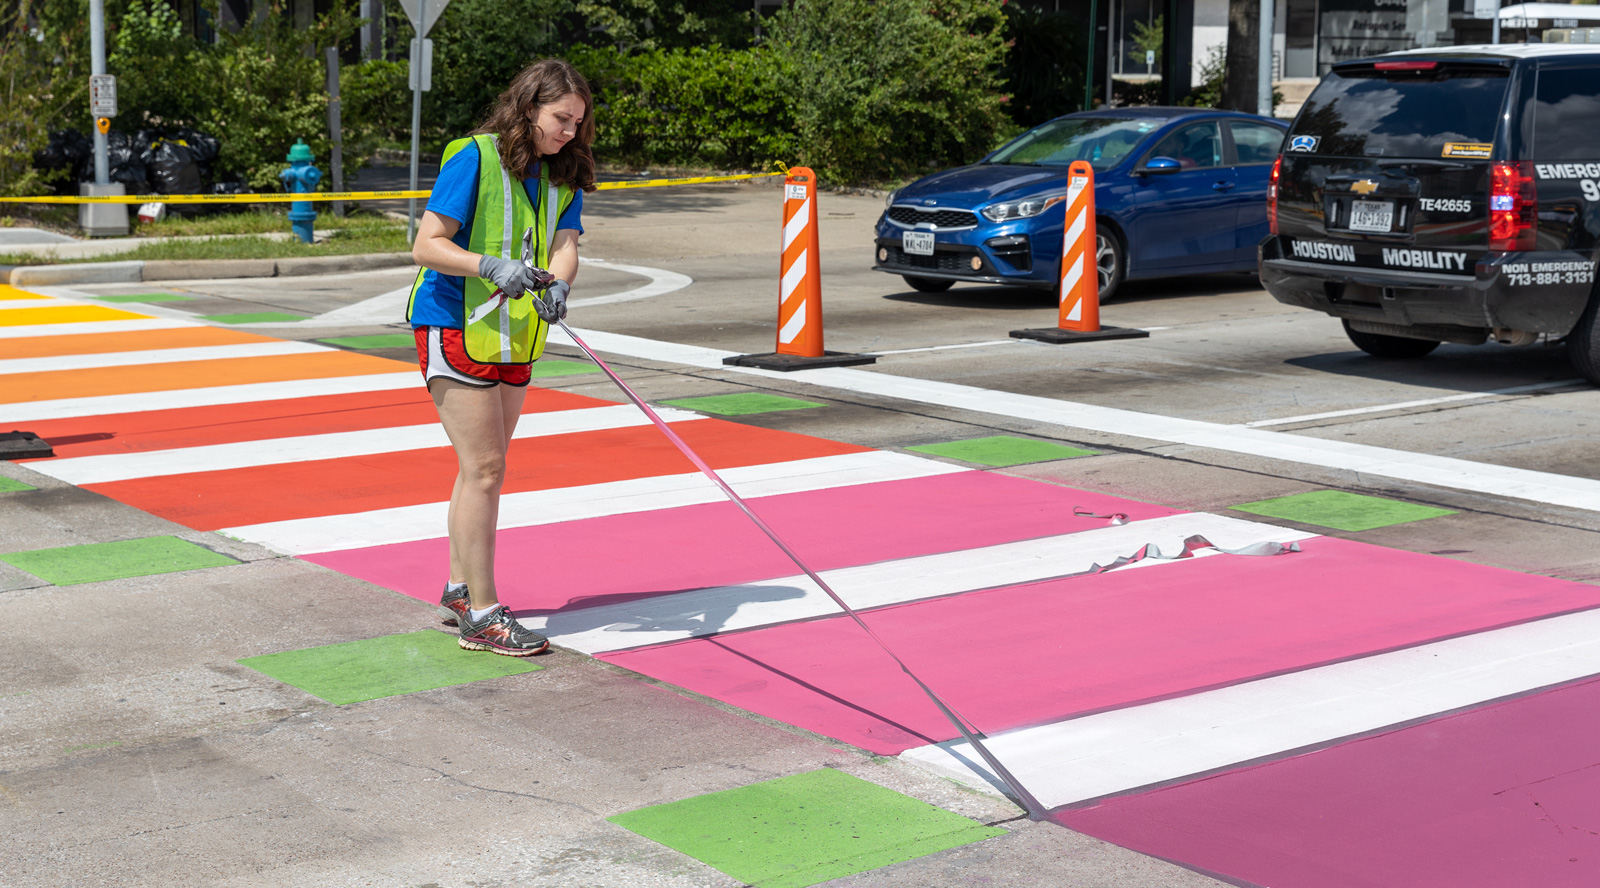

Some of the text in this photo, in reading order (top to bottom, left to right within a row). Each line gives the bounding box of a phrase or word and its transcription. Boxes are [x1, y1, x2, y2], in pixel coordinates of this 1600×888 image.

[1501, 18, 1538, 28] METRO
[1419, 198, 1472, 213] TE42655
[1291, 240, 1467, 270] HOUSTON MOBILITY
[1502, 261, 1595, 274] NON EMERGENCY
[1507, 271, 1595, 287] 713-884-3131
